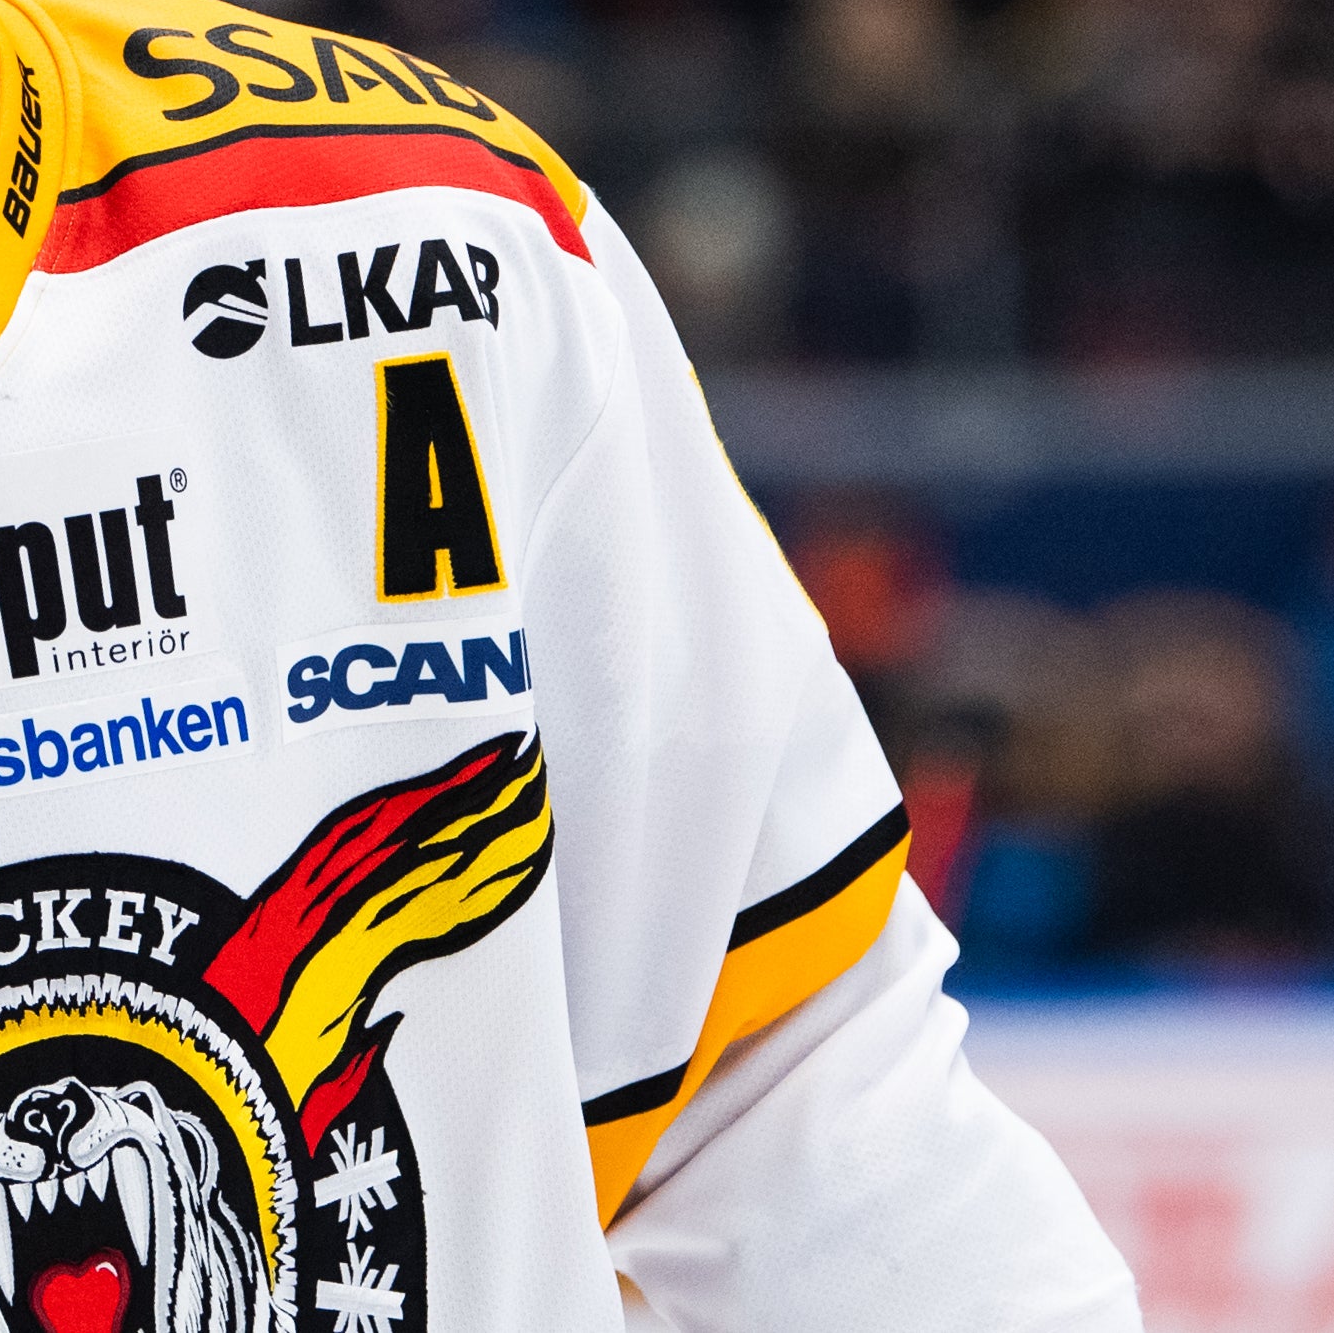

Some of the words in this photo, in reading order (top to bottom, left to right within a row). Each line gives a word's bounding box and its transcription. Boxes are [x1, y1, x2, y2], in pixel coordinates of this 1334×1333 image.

[286, 238, 501, 348] LKAB
[373, 350, 508, 604] A
[51, 629, 191, 674] interiör
